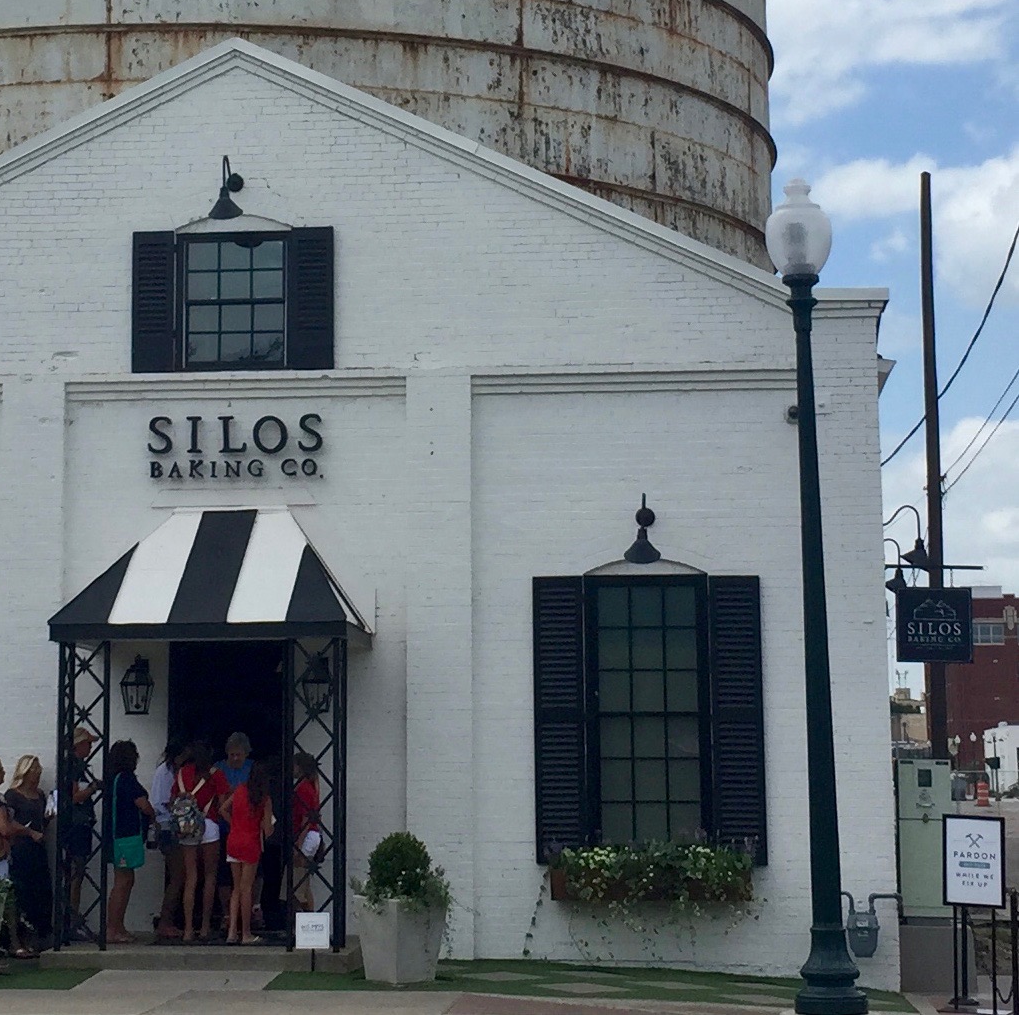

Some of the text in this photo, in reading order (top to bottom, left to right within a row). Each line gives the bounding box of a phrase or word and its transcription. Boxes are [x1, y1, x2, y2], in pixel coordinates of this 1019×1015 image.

[147, 413, 323, 454] SILOS
[149, 458, 324, 479] BAKING CO.
[907, 621, 962, 636] SILOS
[953, 850, 996, 861] PARDON
